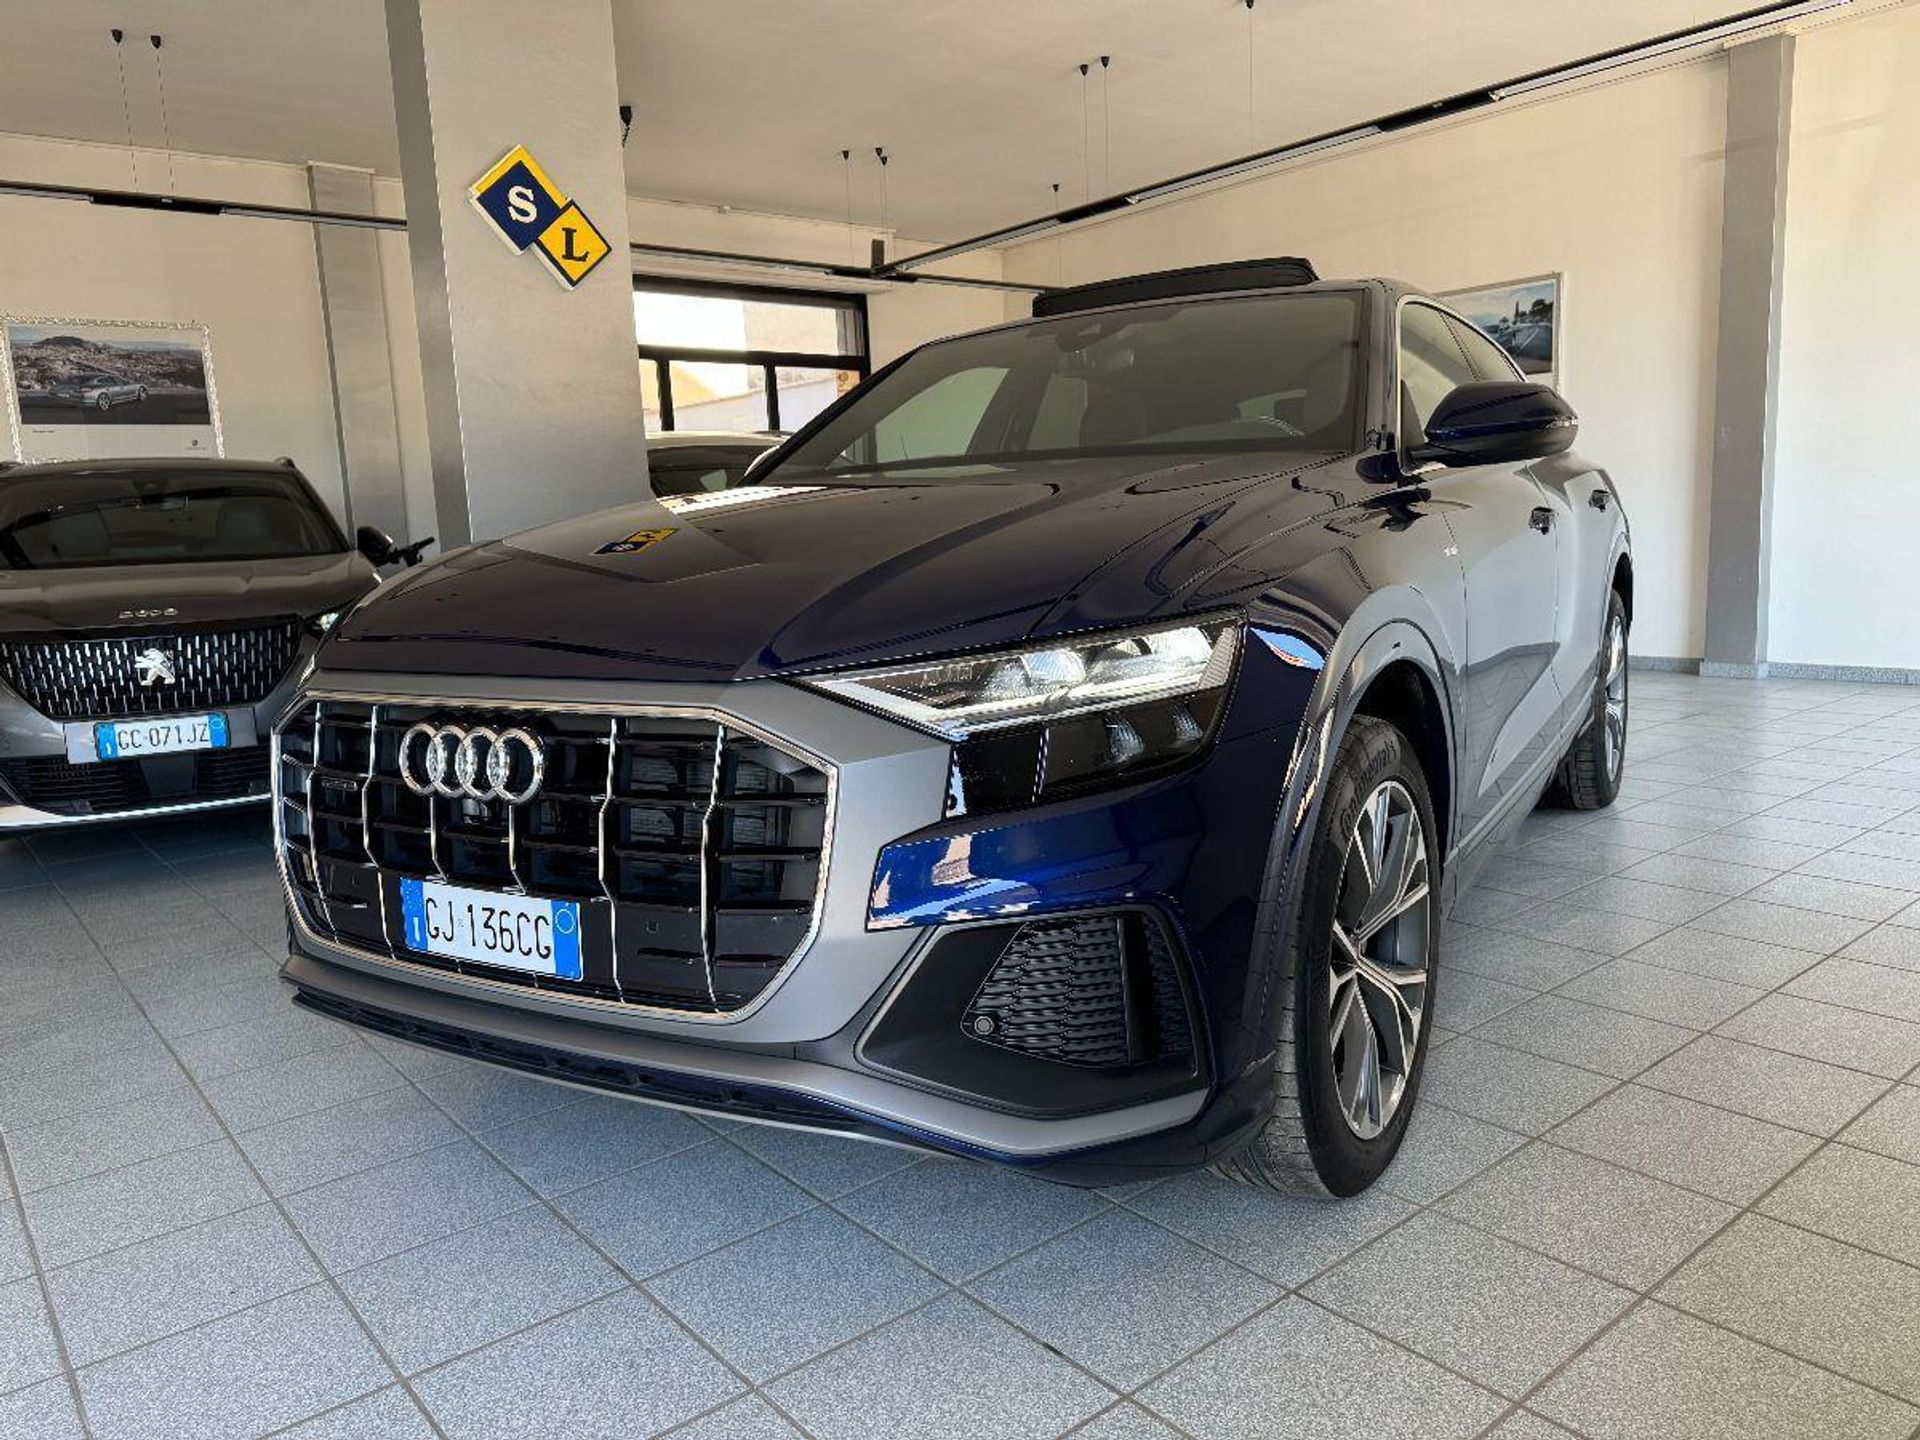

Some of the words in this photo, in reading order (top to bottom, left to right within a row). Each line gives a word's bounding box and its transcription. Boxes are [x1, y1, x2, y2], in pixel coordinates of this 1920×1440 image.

[507, 185, 538, 224] S
[561, 227, 590, 262] L
[117, 729, 142, 750] GC
[148, 722, 209, 748] 071JZ
[412, 916, 421, 943] I
[425, 897, 455, 943] GJ
[466, 903, 552, 960] 136CG
